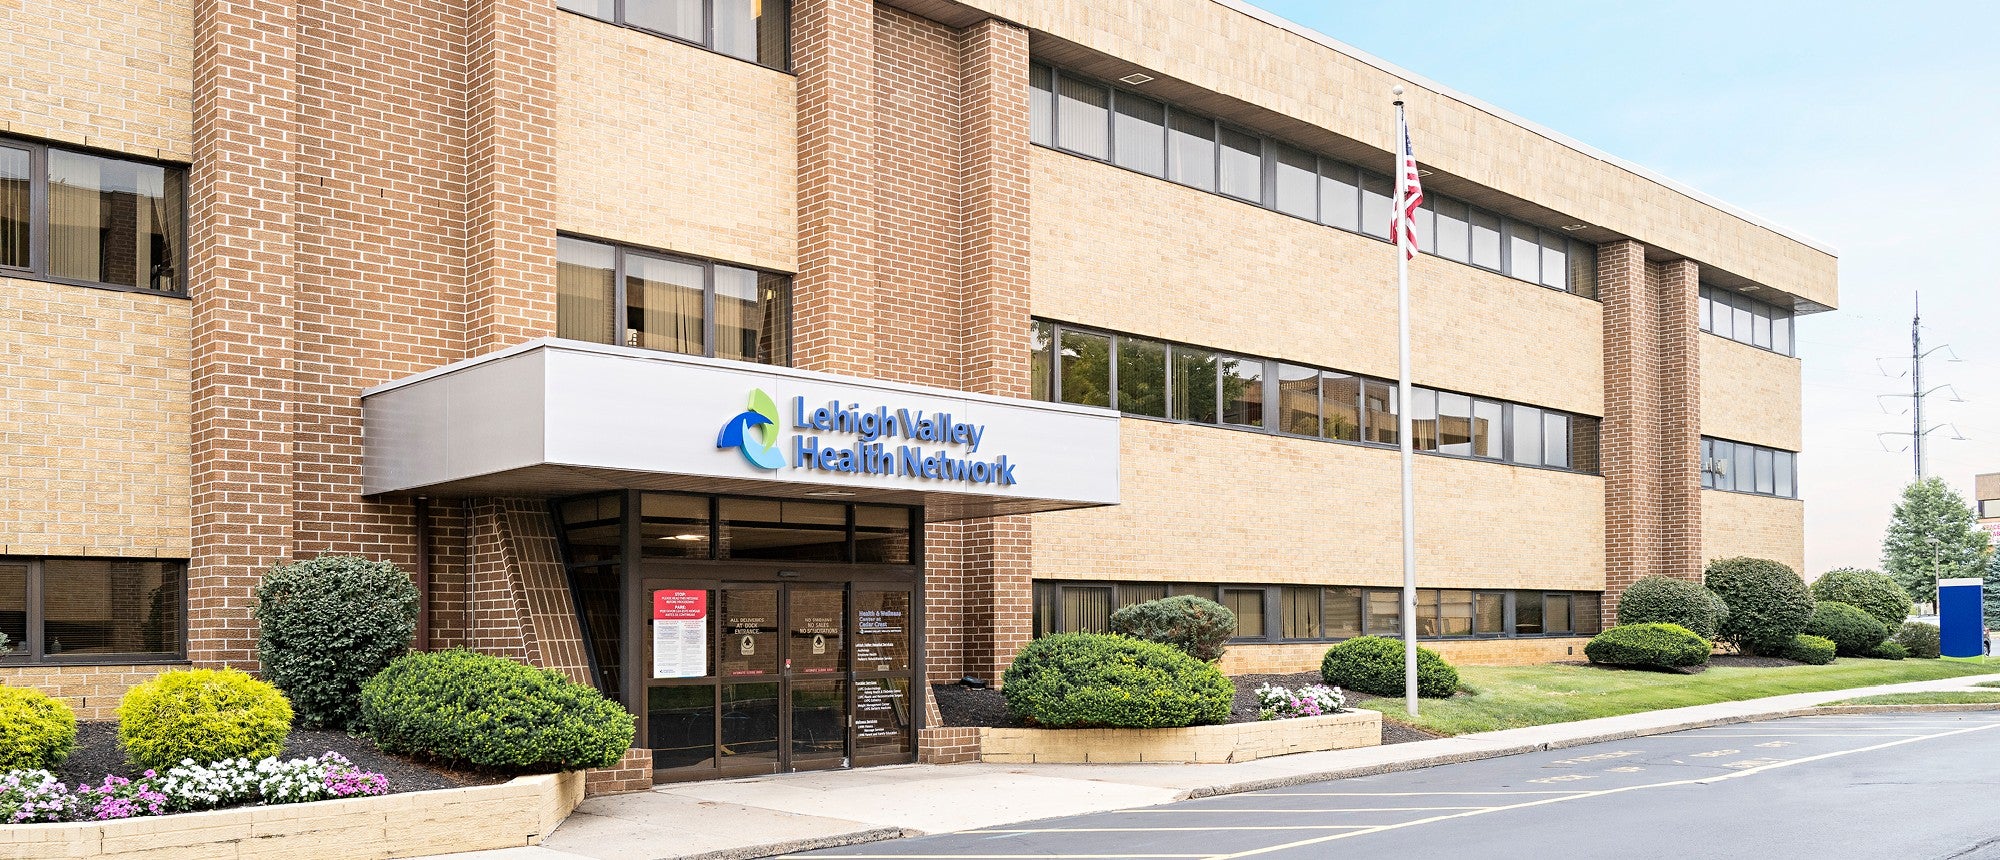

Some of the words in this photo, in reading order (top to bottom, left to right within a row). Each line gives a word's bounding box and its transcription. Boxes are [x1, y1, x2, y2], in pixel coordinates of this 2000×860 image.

[793, 396, 897, 442] Lehigh
[898, 408, 985, 453] Valley
[793, 435, 894, 475] Health
[898, 445, 1017, 485] Network
